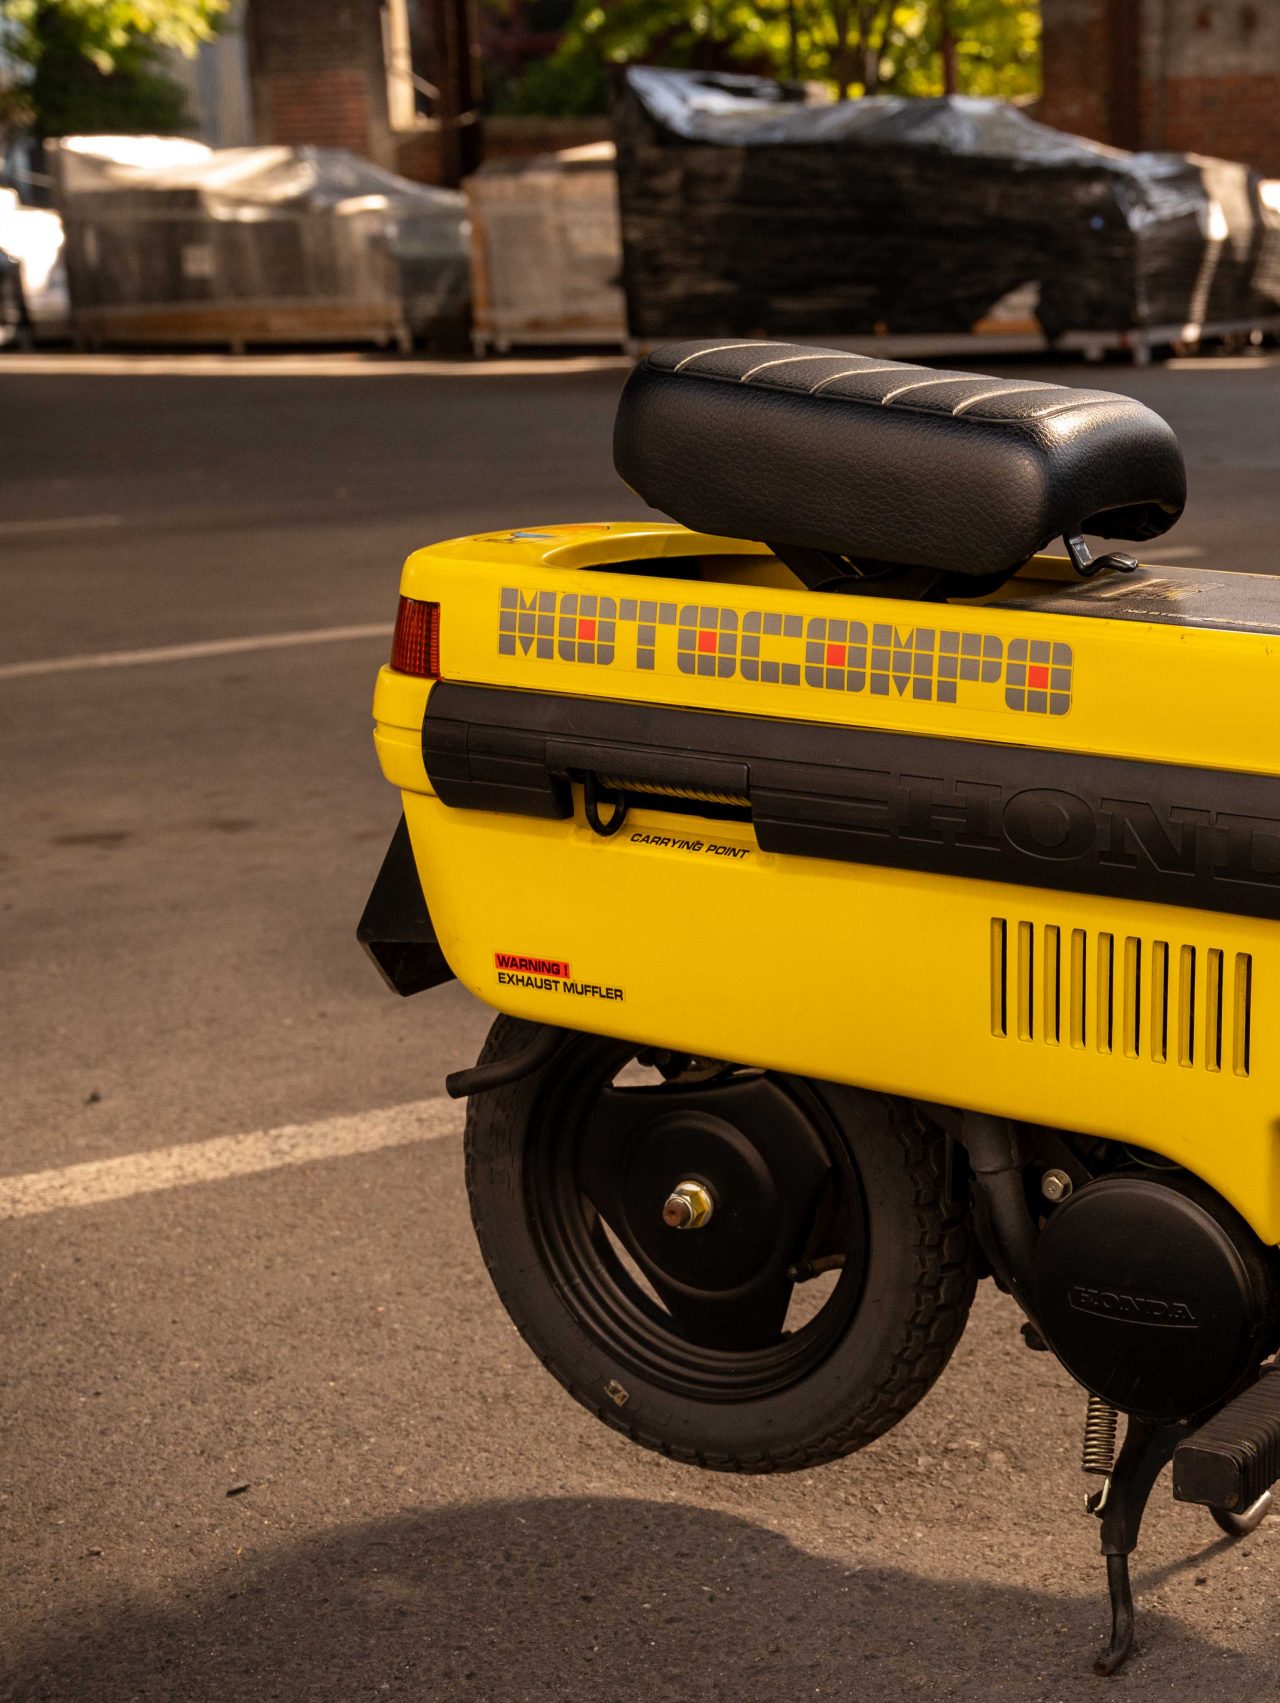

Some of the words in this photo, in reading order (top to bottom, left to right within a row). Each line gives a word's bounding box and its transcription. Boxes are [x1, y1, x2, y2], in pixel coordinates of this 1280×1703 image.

[499, 587, 1073, 716] MOTOCOMPO
[630, 833, 704, 852] CARRYING
[705, 844, 750, 859] POINT
[497, 955, 560, 975] WARNING
[498, 972, 560, 992] EXHAUST
[563, 981, 623, 1001] MUFFLER
[1074, 1286, 1197, 1321] HONDA
